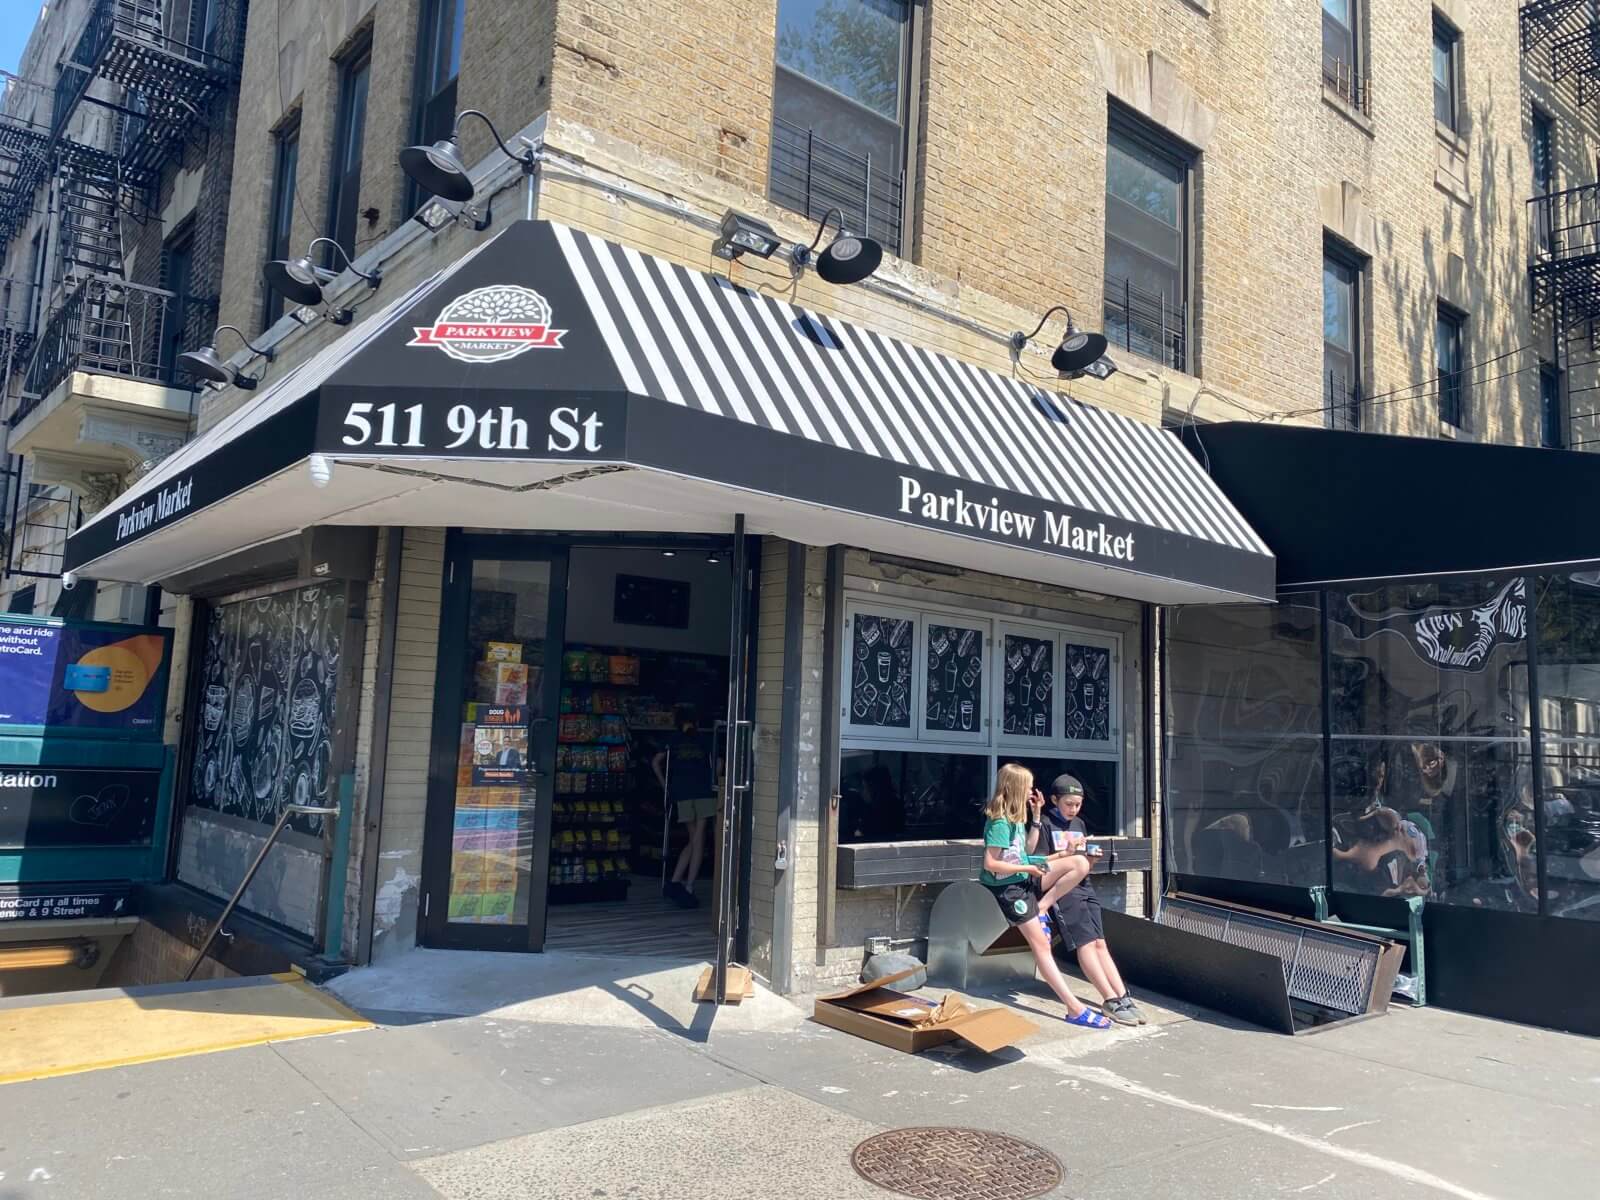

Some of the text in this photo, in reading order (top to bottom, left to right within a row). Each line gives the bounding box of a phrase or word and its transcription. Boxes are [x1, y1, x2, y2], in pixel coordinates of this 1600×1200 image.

[445, 326, 535, 338] PARKVIEW
[342, 402, 604, 452] 511 9th St
[116, 476, 193, 541] Parkview Market
[898, 475, 1136, 562] Parkview Market
[13, 627, 32, 636] and
[34, 629, 53, 638] ride
[0, 635, 38, 645] without
[43, 899, 54, 907] at
[57, 897, 69, 906] all
[72, 895, 100, 905] times
[29, 909, 37, 917] &
[41, 907, 49, 917] 9
[53, 906, 85, 916] Street
